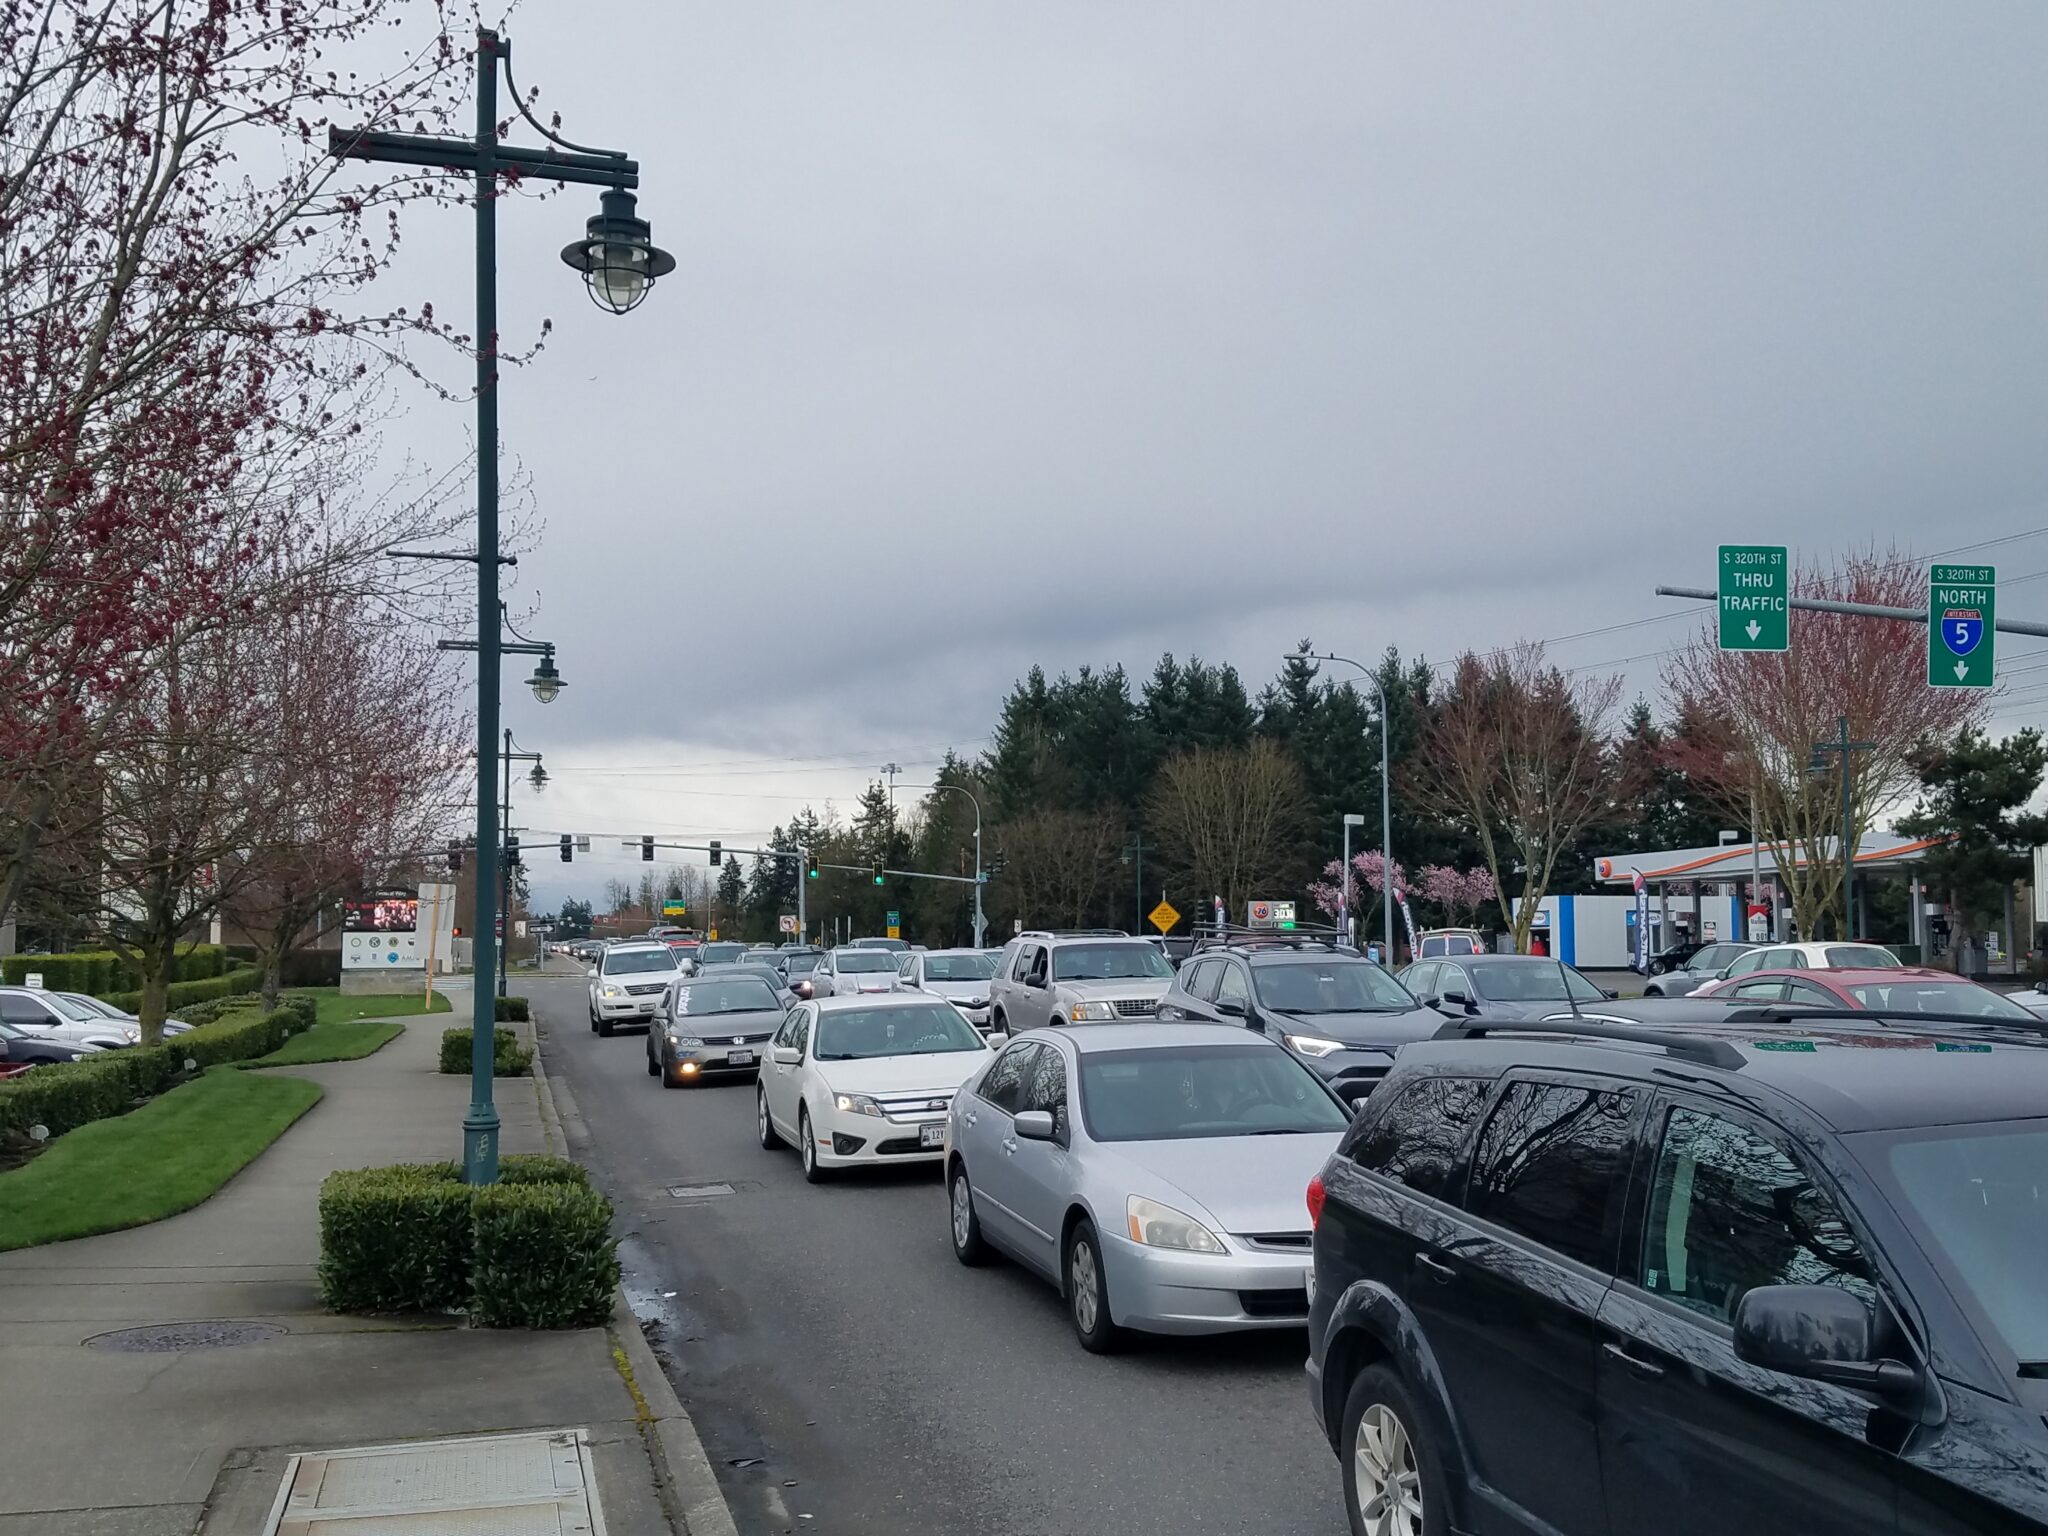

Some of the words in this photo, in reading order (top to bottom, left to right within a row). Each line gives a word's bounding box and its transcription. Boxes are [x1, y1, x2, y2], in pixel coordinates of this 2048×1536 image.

[1724, 553, 1730, 564] S
[1735, 553, 1766, 564] 320TH
[1770, 553, 1782, 565] ST
[1733, 573, 1773, 588] THRU
[1937, 569, 1944, 580] S
[1947, 569, 1975, 580] 320TH
[1979, 570, 1989, 581] ST
[1722, 596, 1784, 611] TRAFFIC
[1940, 590, 1986, 605] NORTH
[1956, 622, 1969, 645] 5
[1255, 907, 1267, 915] 76
